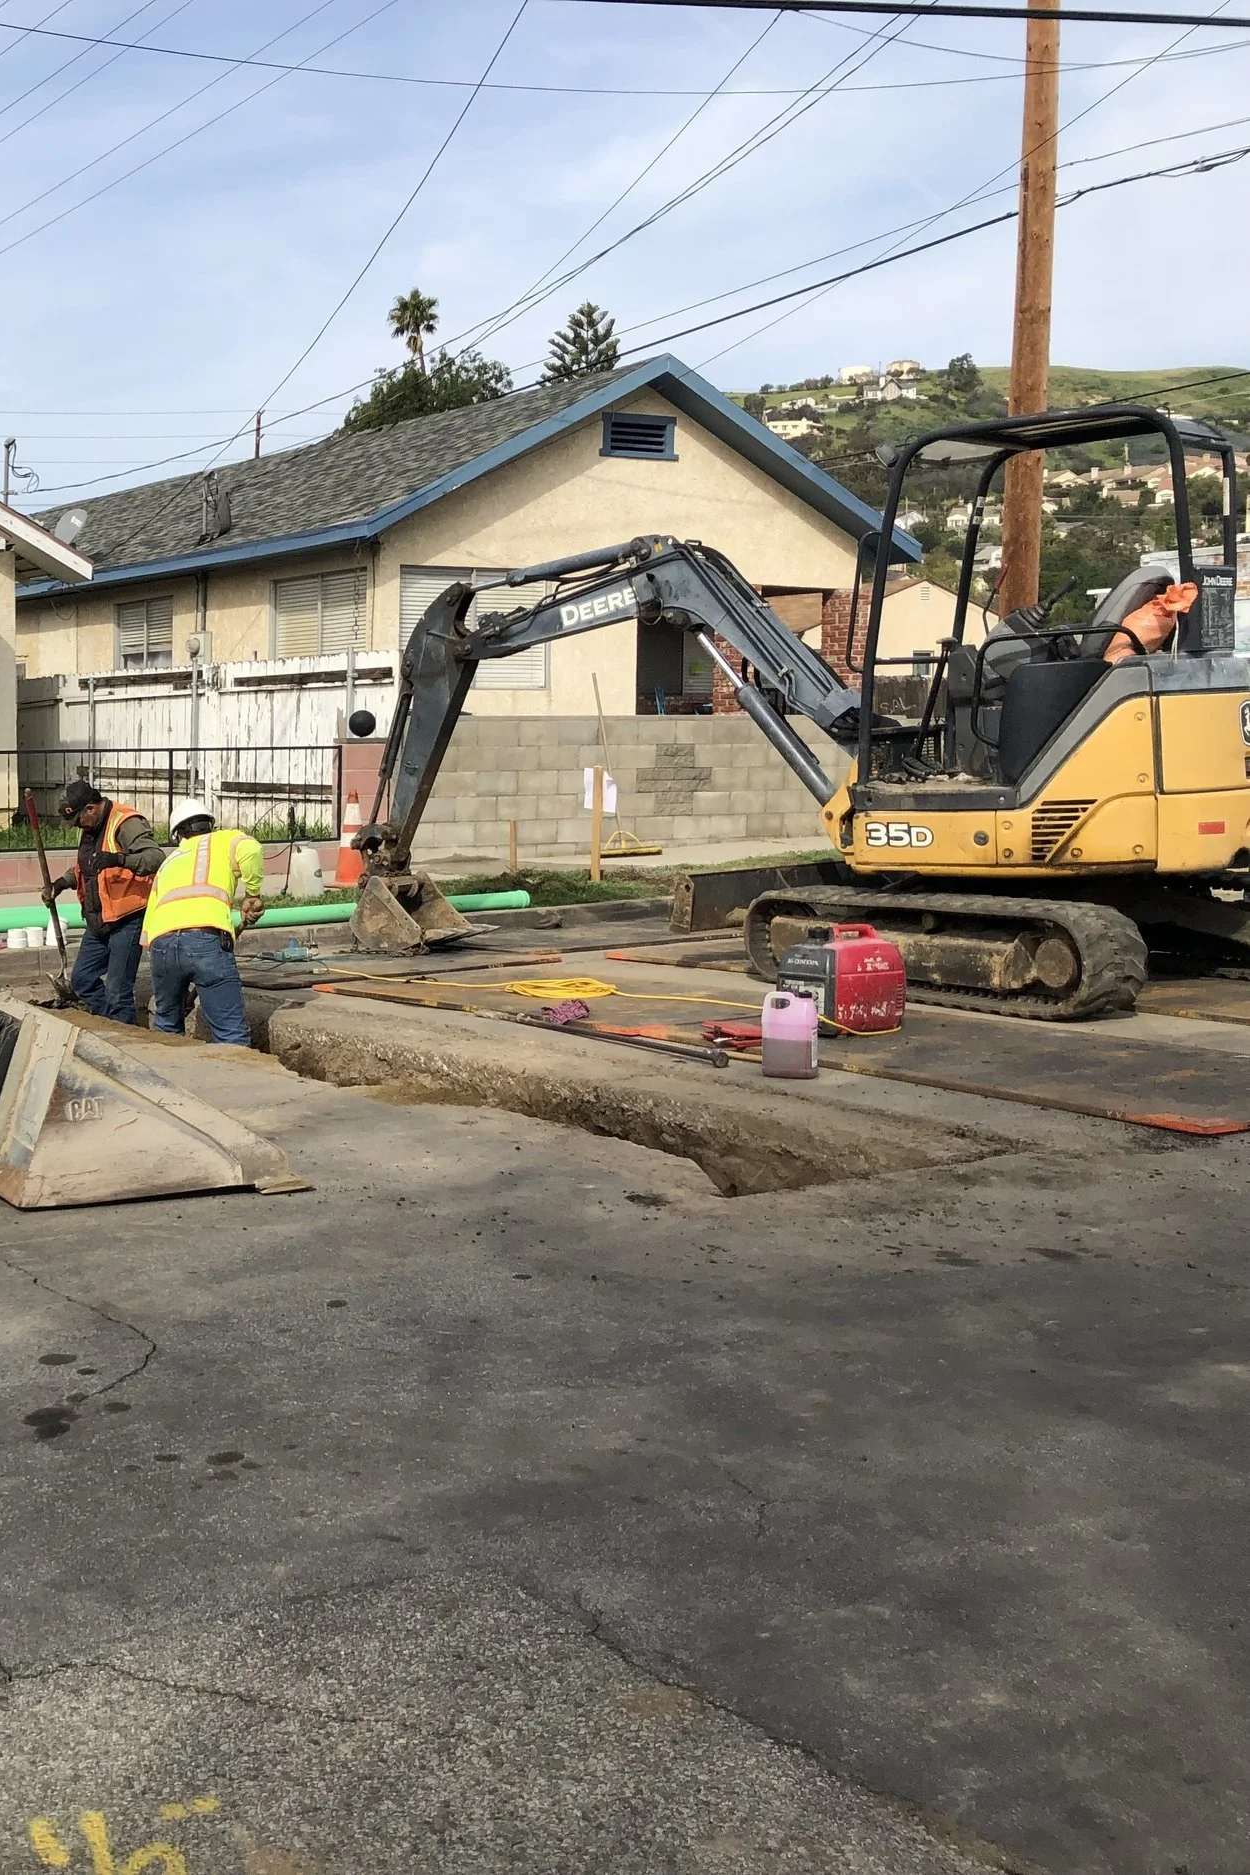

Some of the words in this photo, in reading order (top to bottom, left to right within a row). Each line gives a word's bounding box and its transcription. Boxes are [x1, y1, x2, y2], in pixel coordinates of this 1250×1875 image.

[561, 586, 637, 627] DEERE
[865, 821, 934, 848] 35D
[68, 1096, 104, 1121] CAT
